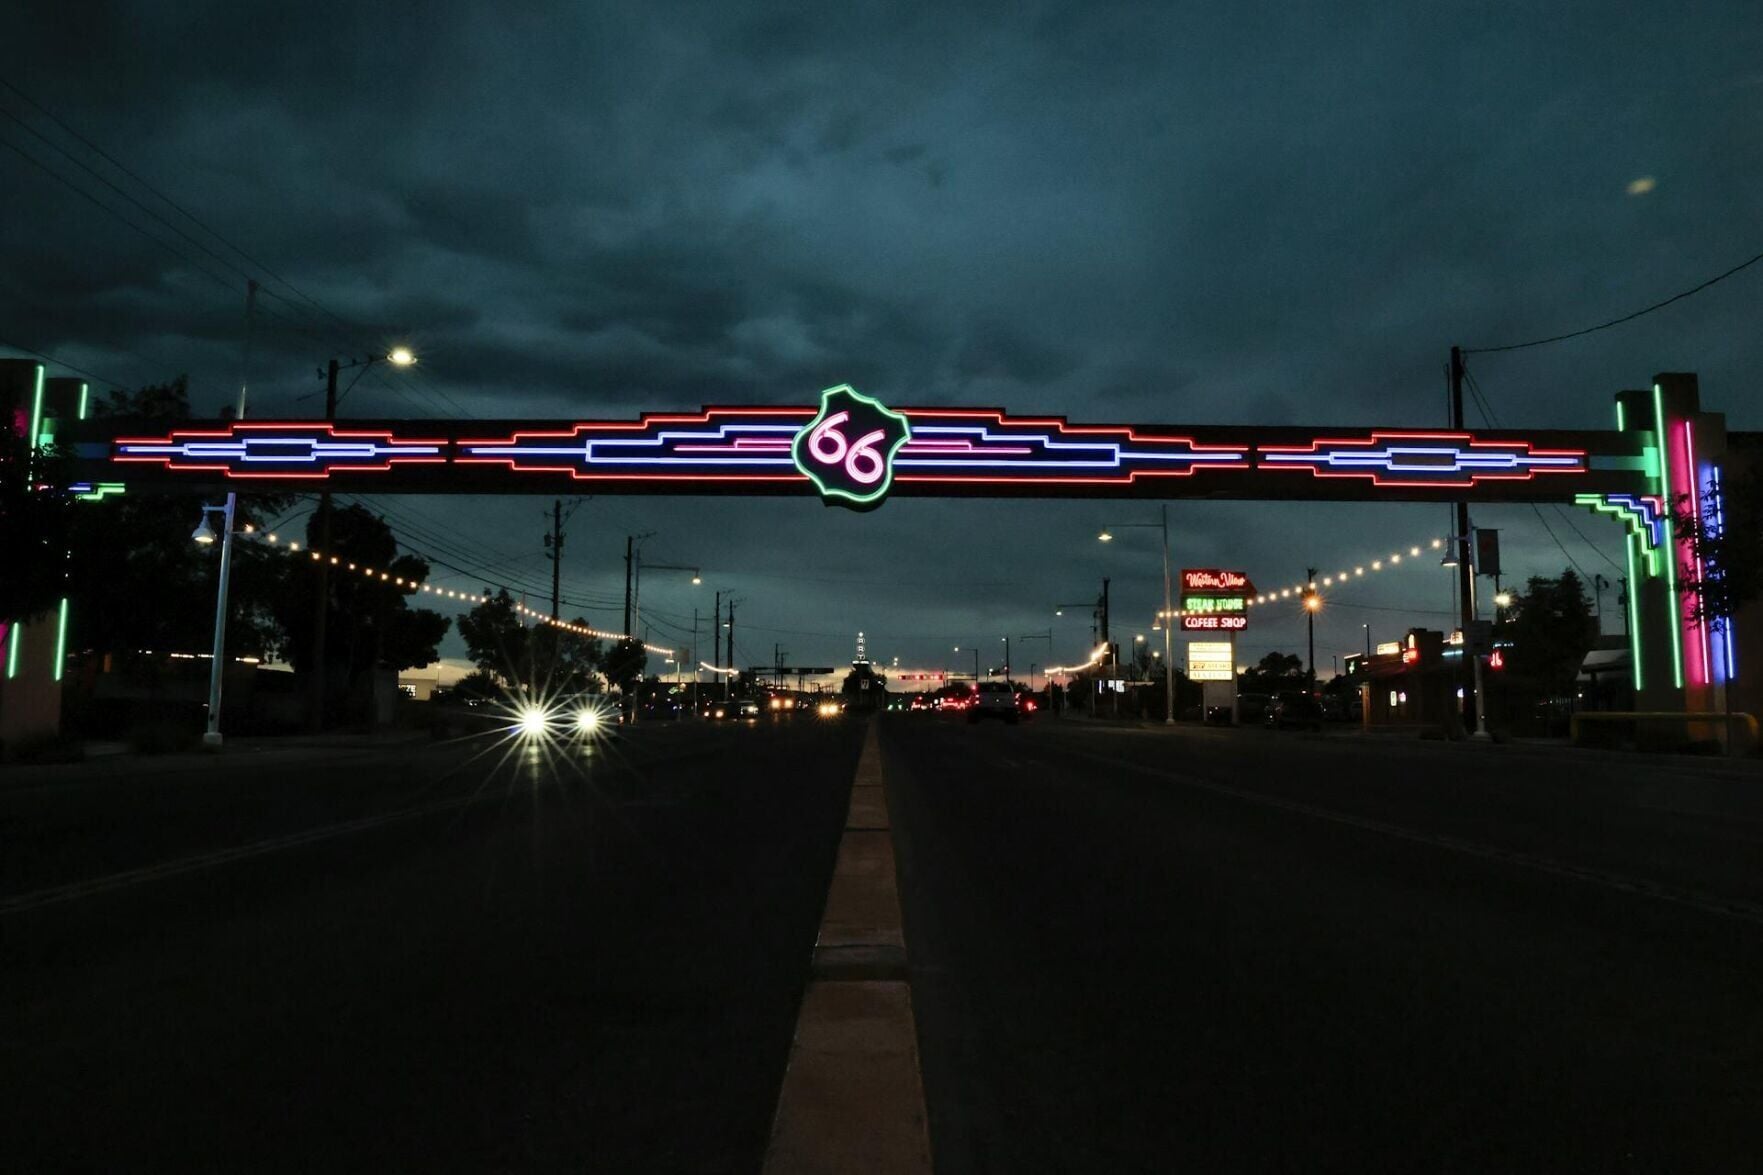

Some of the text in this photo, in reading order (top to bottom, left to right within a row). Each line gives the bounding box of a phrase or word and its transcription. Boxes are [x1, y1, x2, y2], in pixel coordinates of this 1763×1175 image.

[808, 410, 885, 484] 66
[1185, 617, 1246, 628] COFFEE SHOP
